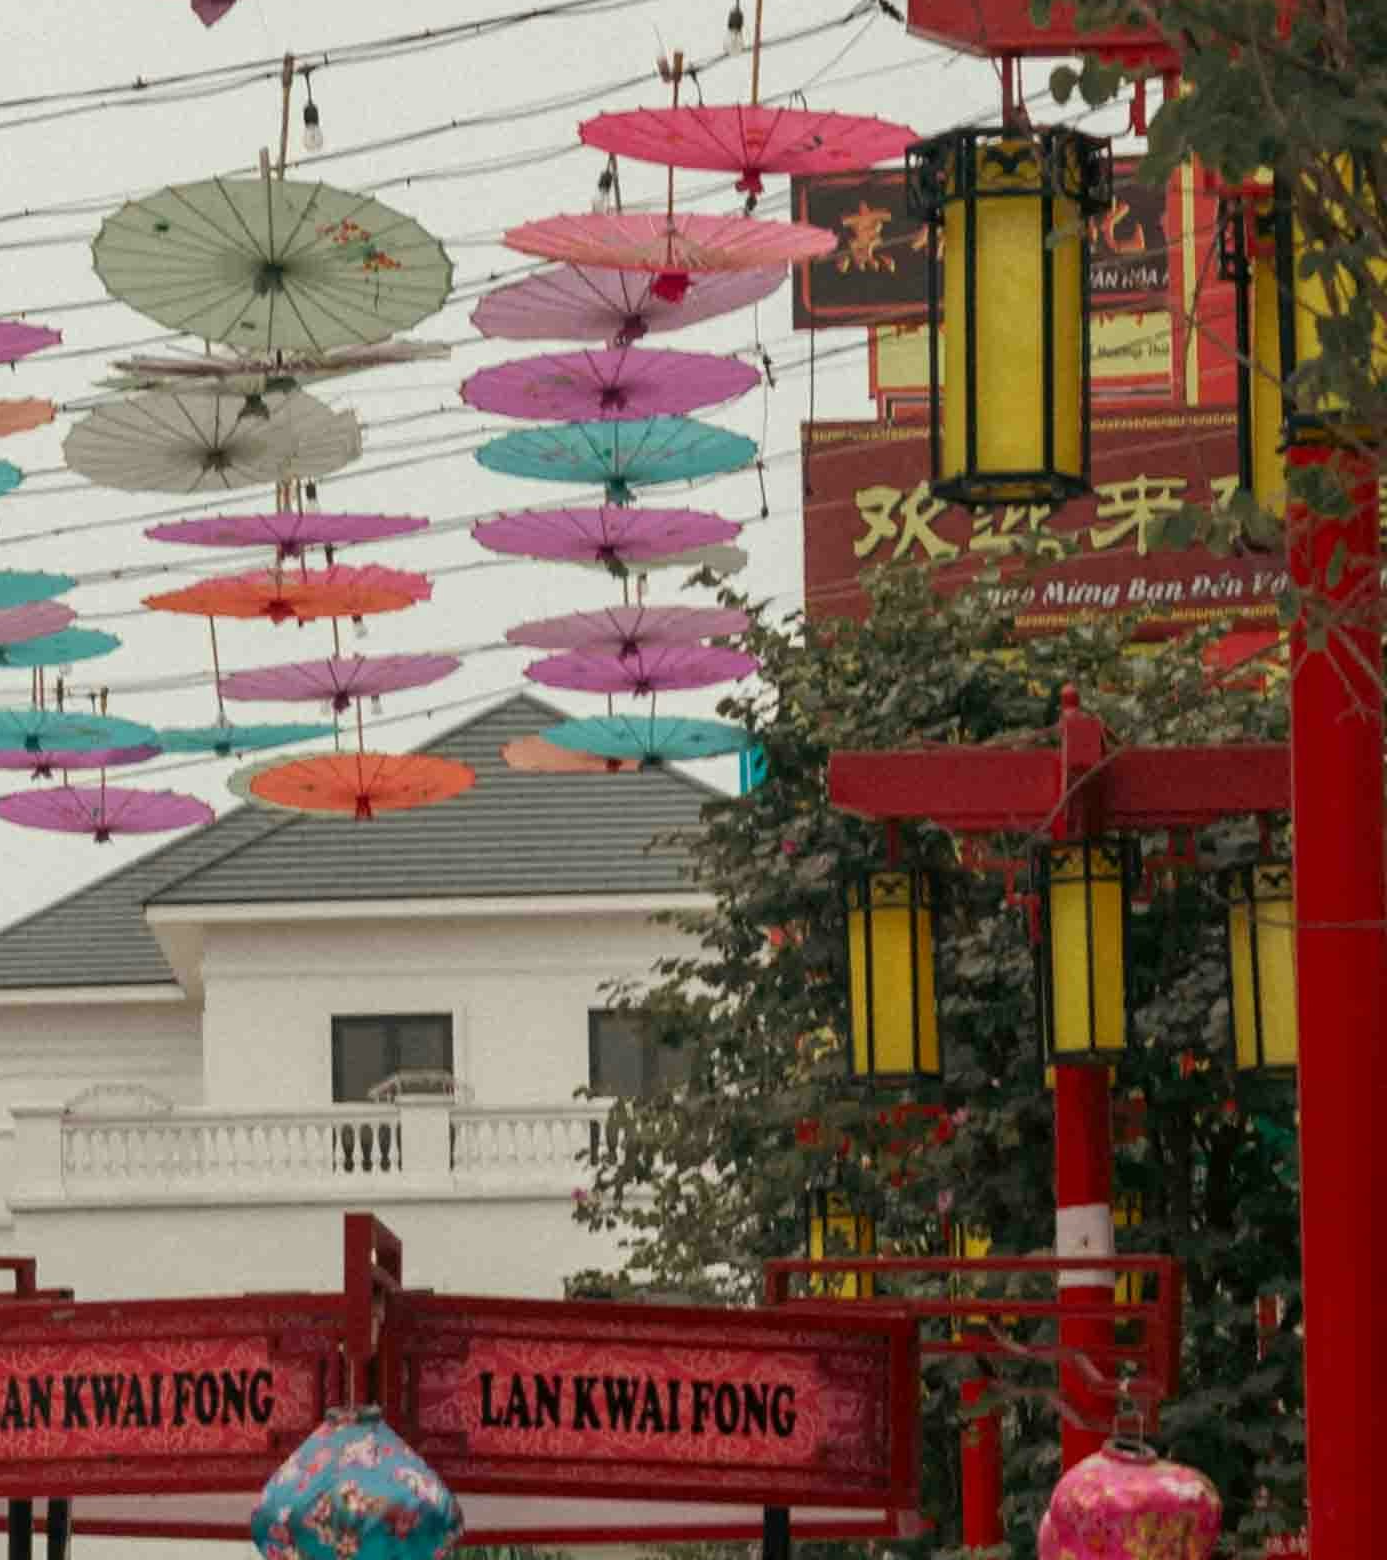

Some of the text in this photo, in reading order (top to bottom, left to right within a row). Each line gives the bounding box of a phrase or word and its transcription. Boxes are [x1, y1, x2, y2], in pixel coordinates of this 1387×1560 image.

[63, 1371, 164, 1428] KWAI
[173, 1368, 276, 1426] FONG
[480, 1372, 797, 1437] LAN KWAI FONG
